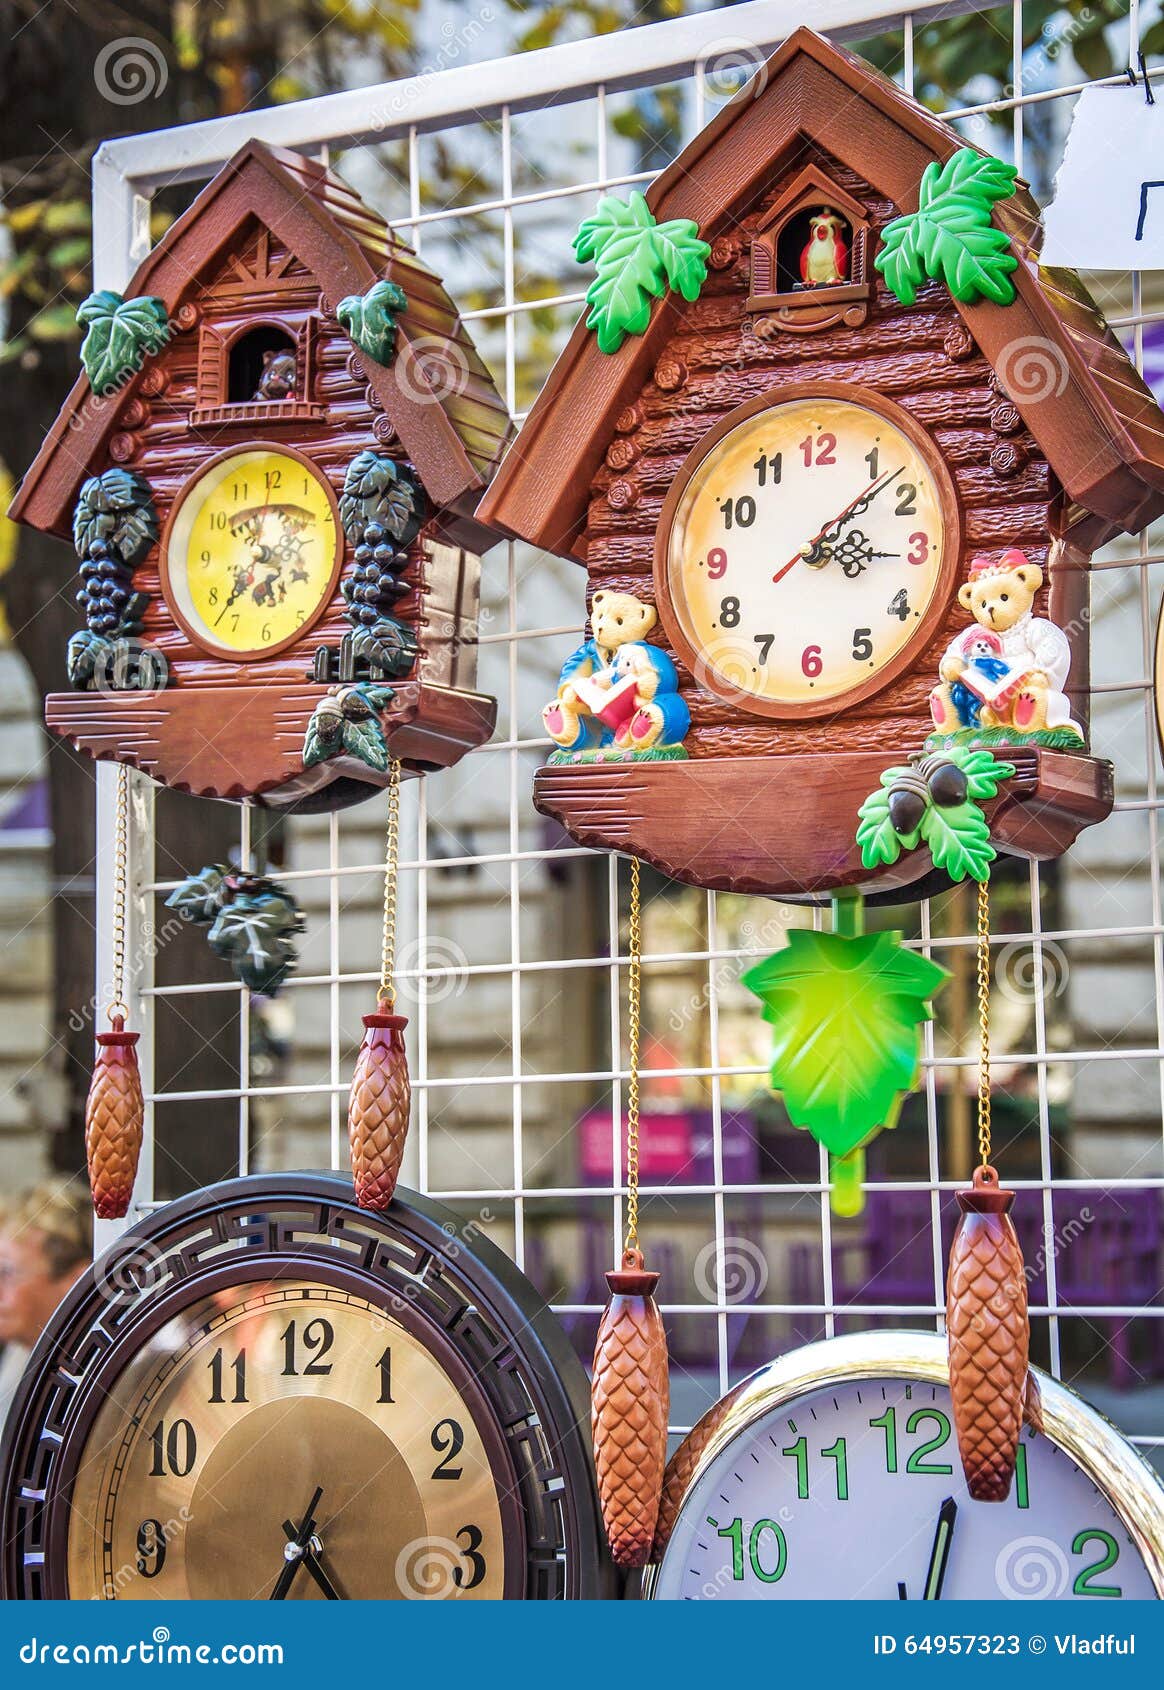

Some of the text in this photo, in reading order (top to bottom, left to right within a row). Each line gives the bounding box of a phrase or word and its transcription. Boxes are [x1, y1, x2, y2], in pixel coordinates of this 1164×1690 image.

[799, 432, 837, 467] 12
[865, 447, 879, 480] 1
[264, 470, 281, 489] 12
[754, 452, 782, 486] 11
[232, 483, 248, 501] 11
[304, 478, 309, 496] 1
[895, 483, 917, 516] 2
[209, 512, 227, 530] 10
[720, 495, 756, 529] 10
[201, 550, 211, 568] 9
[706, 547, 728, 580] 9
[907, 531, 929, 565] 3
[208, 588, 218, 606] 8
[719, 596, 741, 628] 8
[887, 588, 911, 621] 4
[231, 614, 241, 632] 7
[261, 623, 271, 641] 6
[754, 633, 775, 665] 7
[852, 628, 873, 661] 5
[801, 645, 823, 678] 6
[280, 1317, 335, 1376] 12
[207, 1347, 249, 1404] 11
[375, 1346, 397, 1404] 1
[148, 1418, 197, 1477] 10
[430, 1418, 465, 1480] 2
[869, 1406, 953, 1475] 12
[782, 1436, 849, 1500] 11
[1015, 1443, 1030, 1509] 1
[136, 1518, 167, 1579] 9
[452, 1524, 487, 1590] 3
[718, 1517, 788, 1584] 10
[1071, 1529, 1122, 1597] 2
